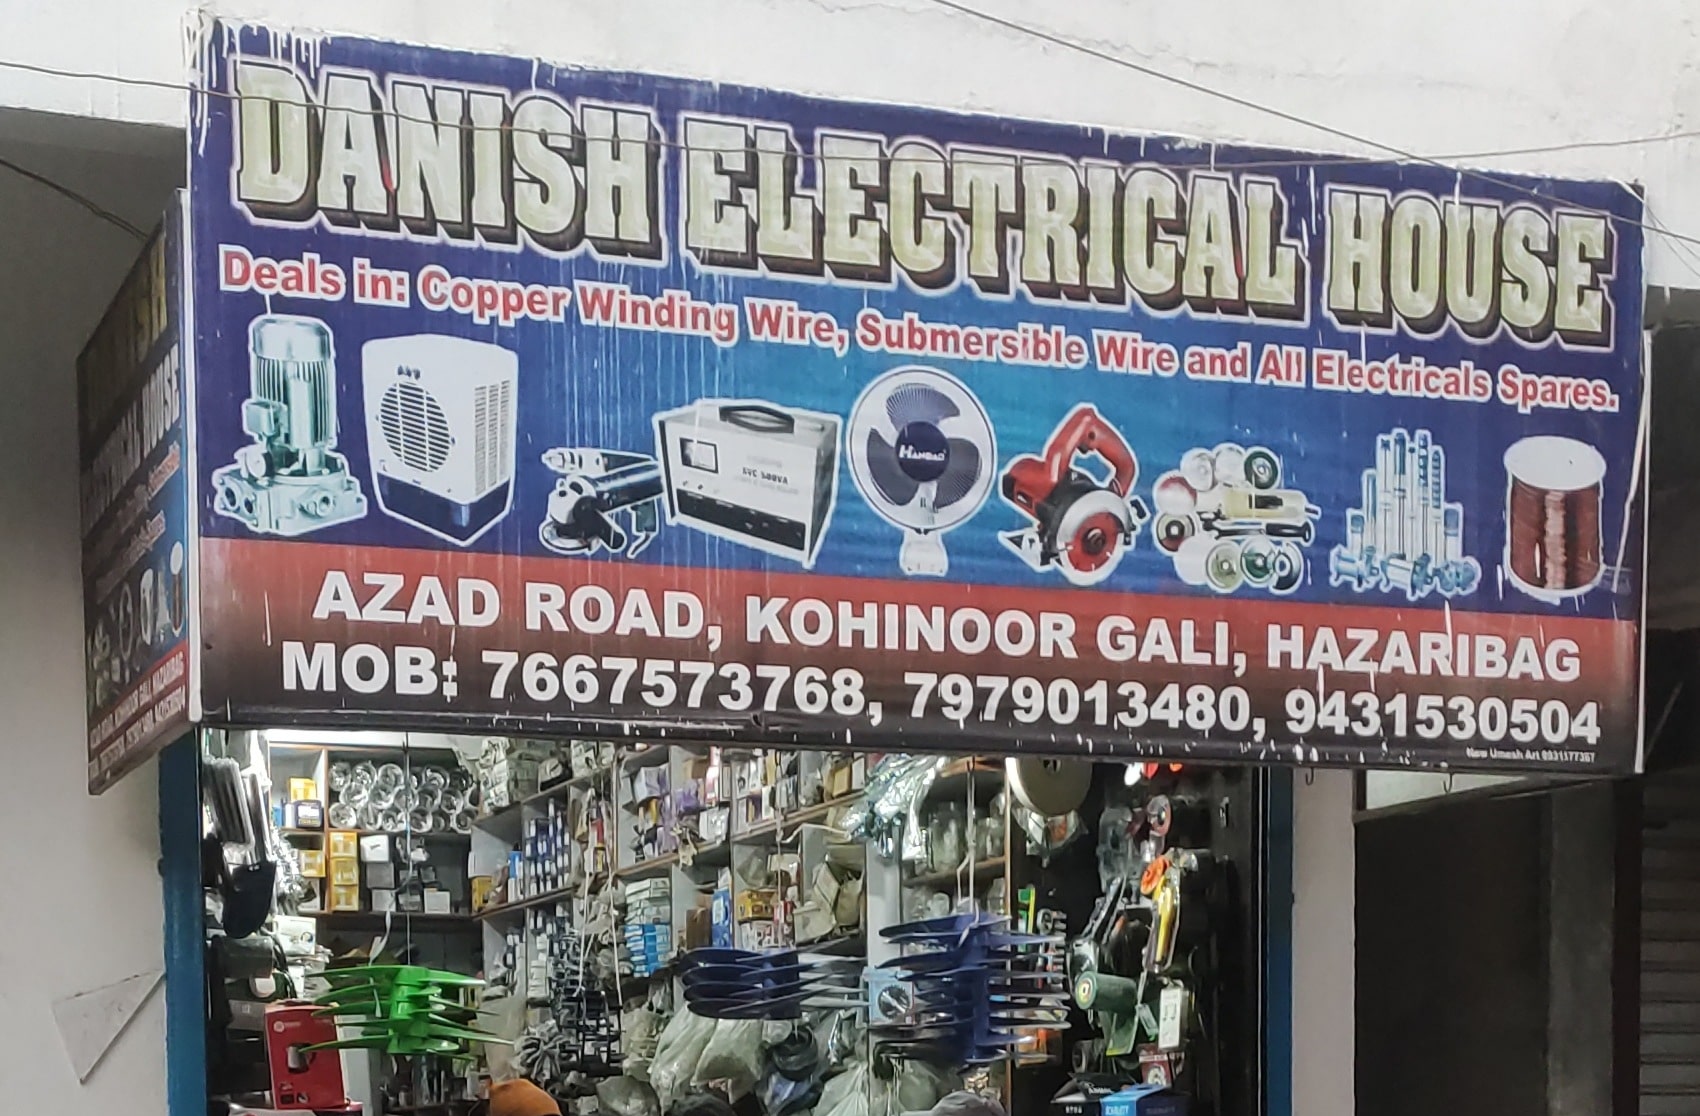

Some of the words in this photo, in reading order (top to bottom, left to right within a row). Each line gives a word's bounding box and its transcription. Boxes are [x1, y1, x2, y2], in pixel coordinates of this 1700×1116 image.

[233, 58, 663, 262] DANISH
[683, 116, 1306, 320] ELECTRICAL
[1325, 186, 1614, 349] HOUSE
[222, 249, 344, 296] Deals
[356, 262, 408, 304] in:
[418, 270, 569, 324] Copper
[579, 287, 736, 344] Winding
[748, 299, 847, 352] Wire,
[857, 311, 1085, 366] Submersible
[1096, 331, 1176, 376] Wire
[1186, 344, 1250, 380] and
[1260, 348, 1304, 385] All
[1314, 355, 1491, 400] Electricals
[1499, 369, 1619, 409] Spares.
[281, 642, 459, 699] MOB:
[480, 650, 884, 727] 7667573768,
[903, 671, 1267, 743] 7979013480,
[1284, 688, 1602, 745] 9431530504
[312, 571, 501, 629] AZAD
[523, 583, 724, 652] ROAD,
[745, 597, 1078, 659] KOHINOOR
[1096, 616, 1247, 678] GALI,
[1266, 624, 1582, 682] HAZARIBAG
